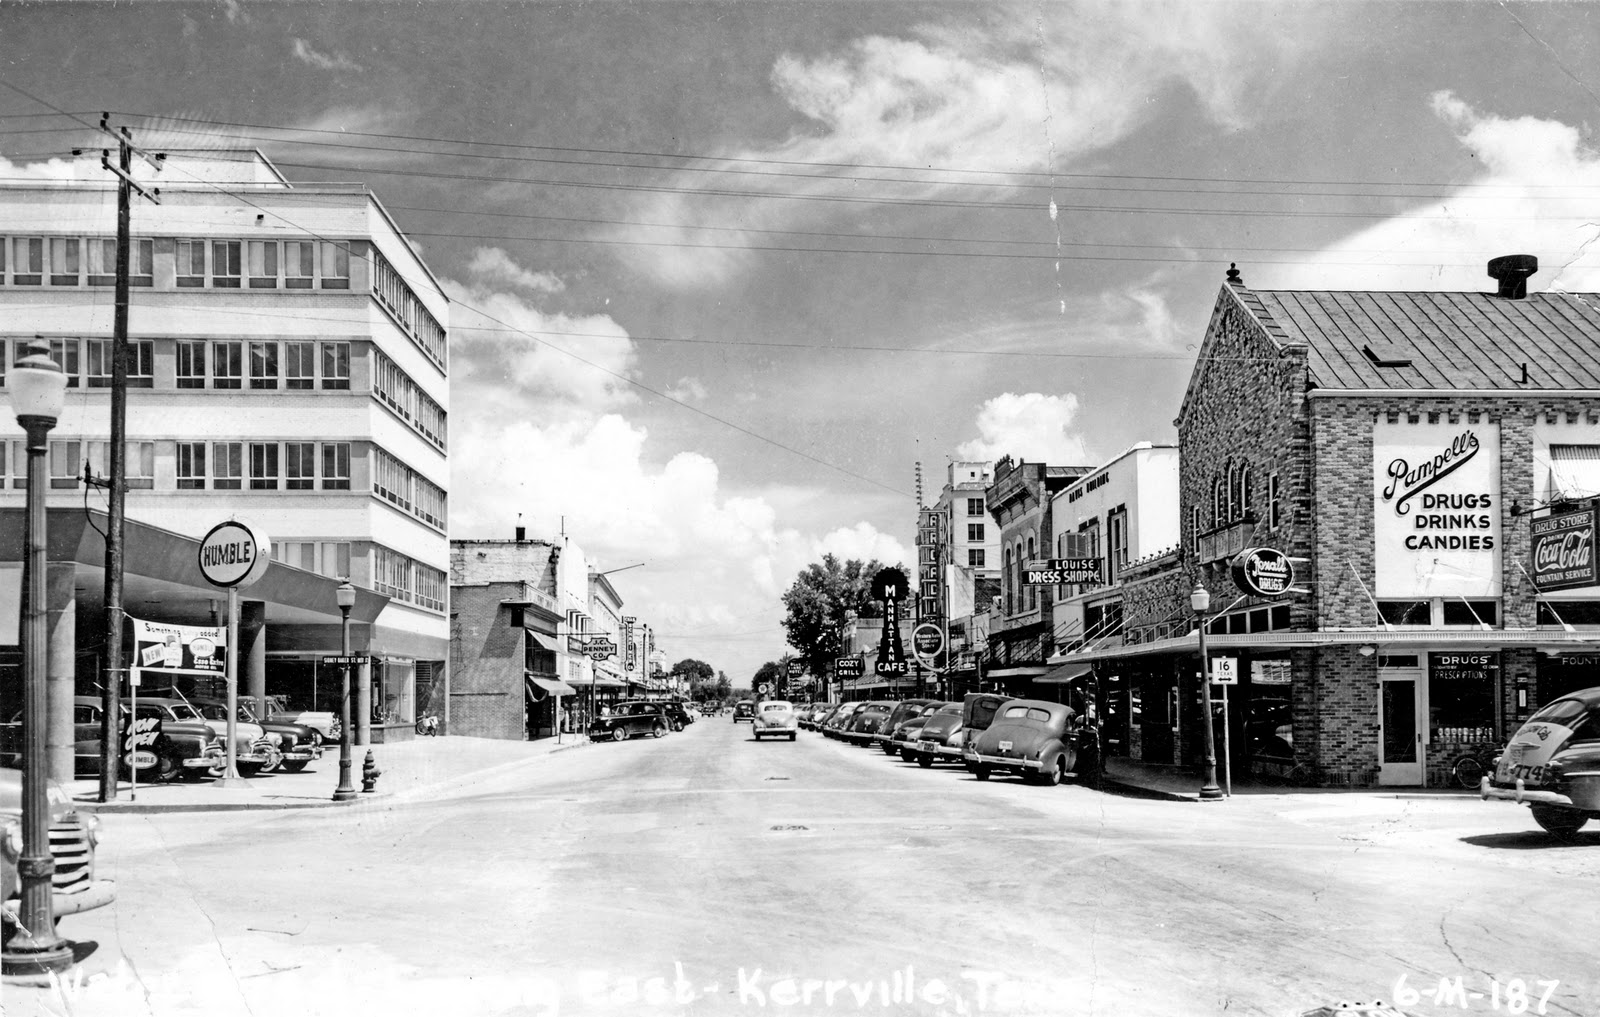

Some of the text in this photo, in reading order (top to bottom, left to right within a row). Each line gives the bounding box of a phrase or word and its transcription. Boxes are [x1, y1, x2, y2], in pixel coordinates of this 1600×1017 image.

[1383, 430, 1480, 501] Pampell's
[1086, 472, 1109, 493] BUILDING
[1423, 494, 1492, 509] DRUGS
[1415, 515, 1491, 529] DRINKS
[1535, 514, 1589, 533] DRUG STORE
[1405, 535, 1494, 550] CANDIES
[1547, 533, 1565, 541] DRINK
[203, 541, 251, 567] HUMBLE
[1535, 529, 1593, 573] Coca-Cola
[1055, 560, 1094, 570] LOUISE
[1029, 571, 1100, 583] DRESS SHOPPE
[1536, 568, 1592, 584] FOUNTAIN SERVICE
[1259, 577, 1285, 591] DRUGS
[145, 622, 181, 638] Something
[885, 584, 896, 661] MANHATTAN
[877, 662, 905, 672] CAFE
[1219, 661, 1230, 671] 16
[1442, 656, 1489, 665] DRUGS
